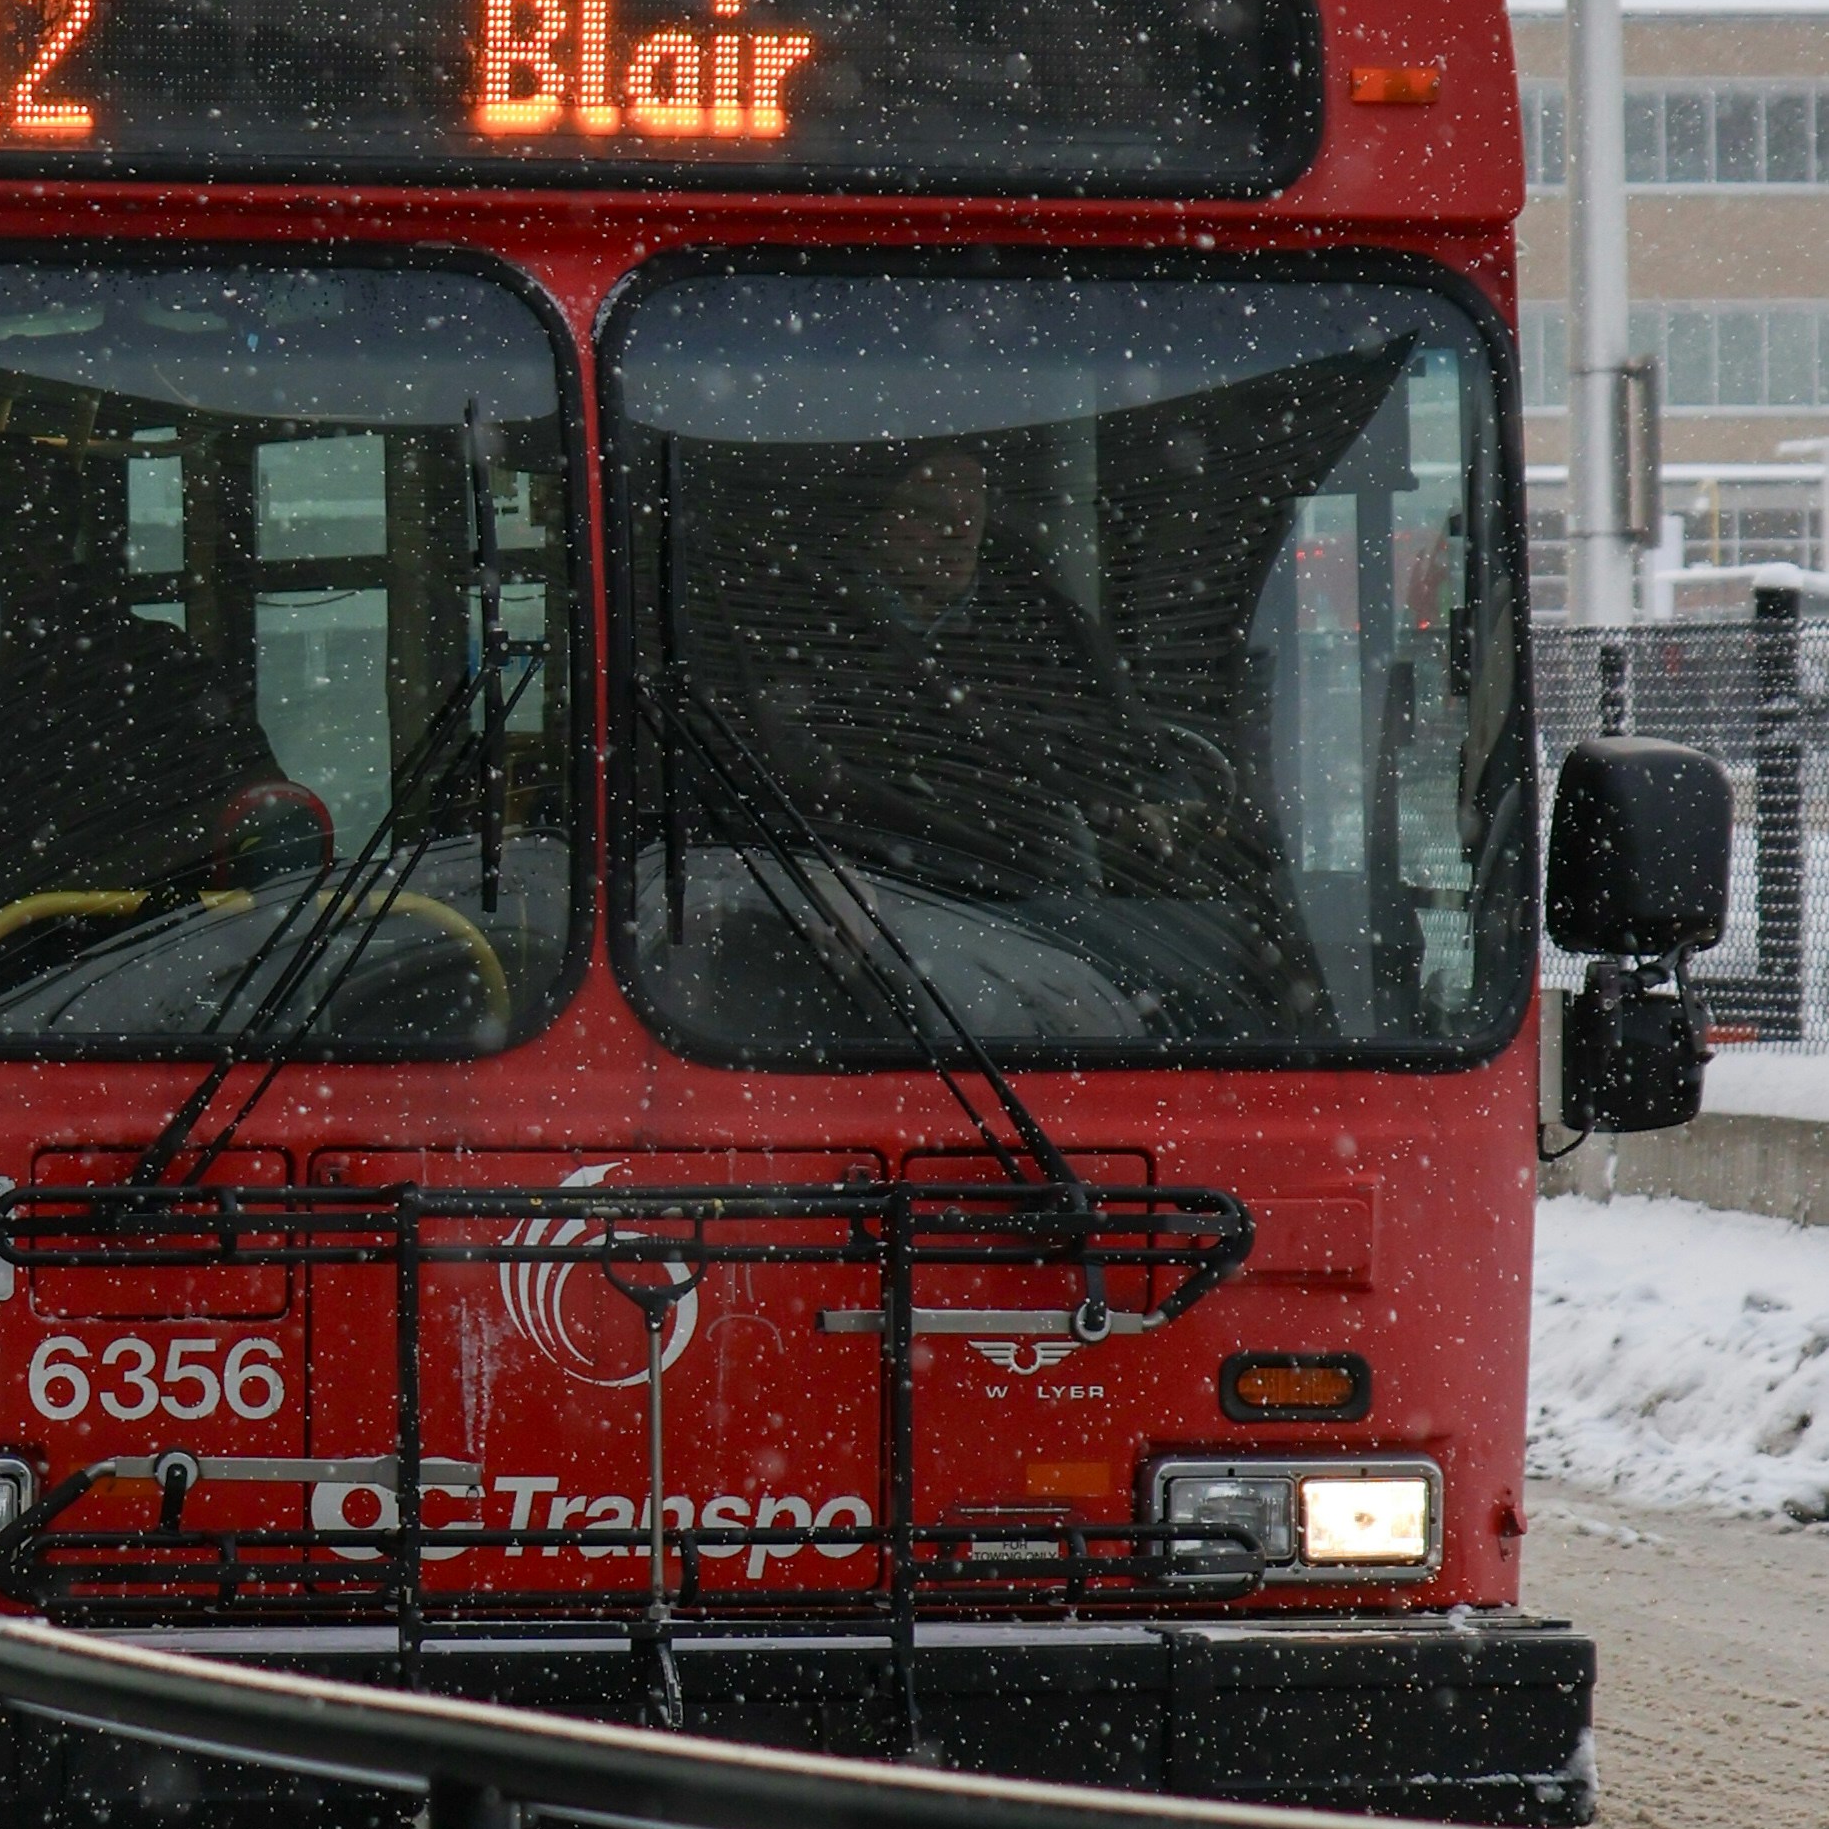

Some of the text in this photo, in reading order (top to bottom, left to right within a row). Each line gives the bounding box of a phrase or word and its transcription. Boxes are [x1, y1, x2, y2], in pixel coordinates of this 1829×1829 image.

[27, 1335, 285, 1422] 6356
[311, 1476, 873, 1580] OC Transpo
[974, 1552, 1023, 1561] TOWING
